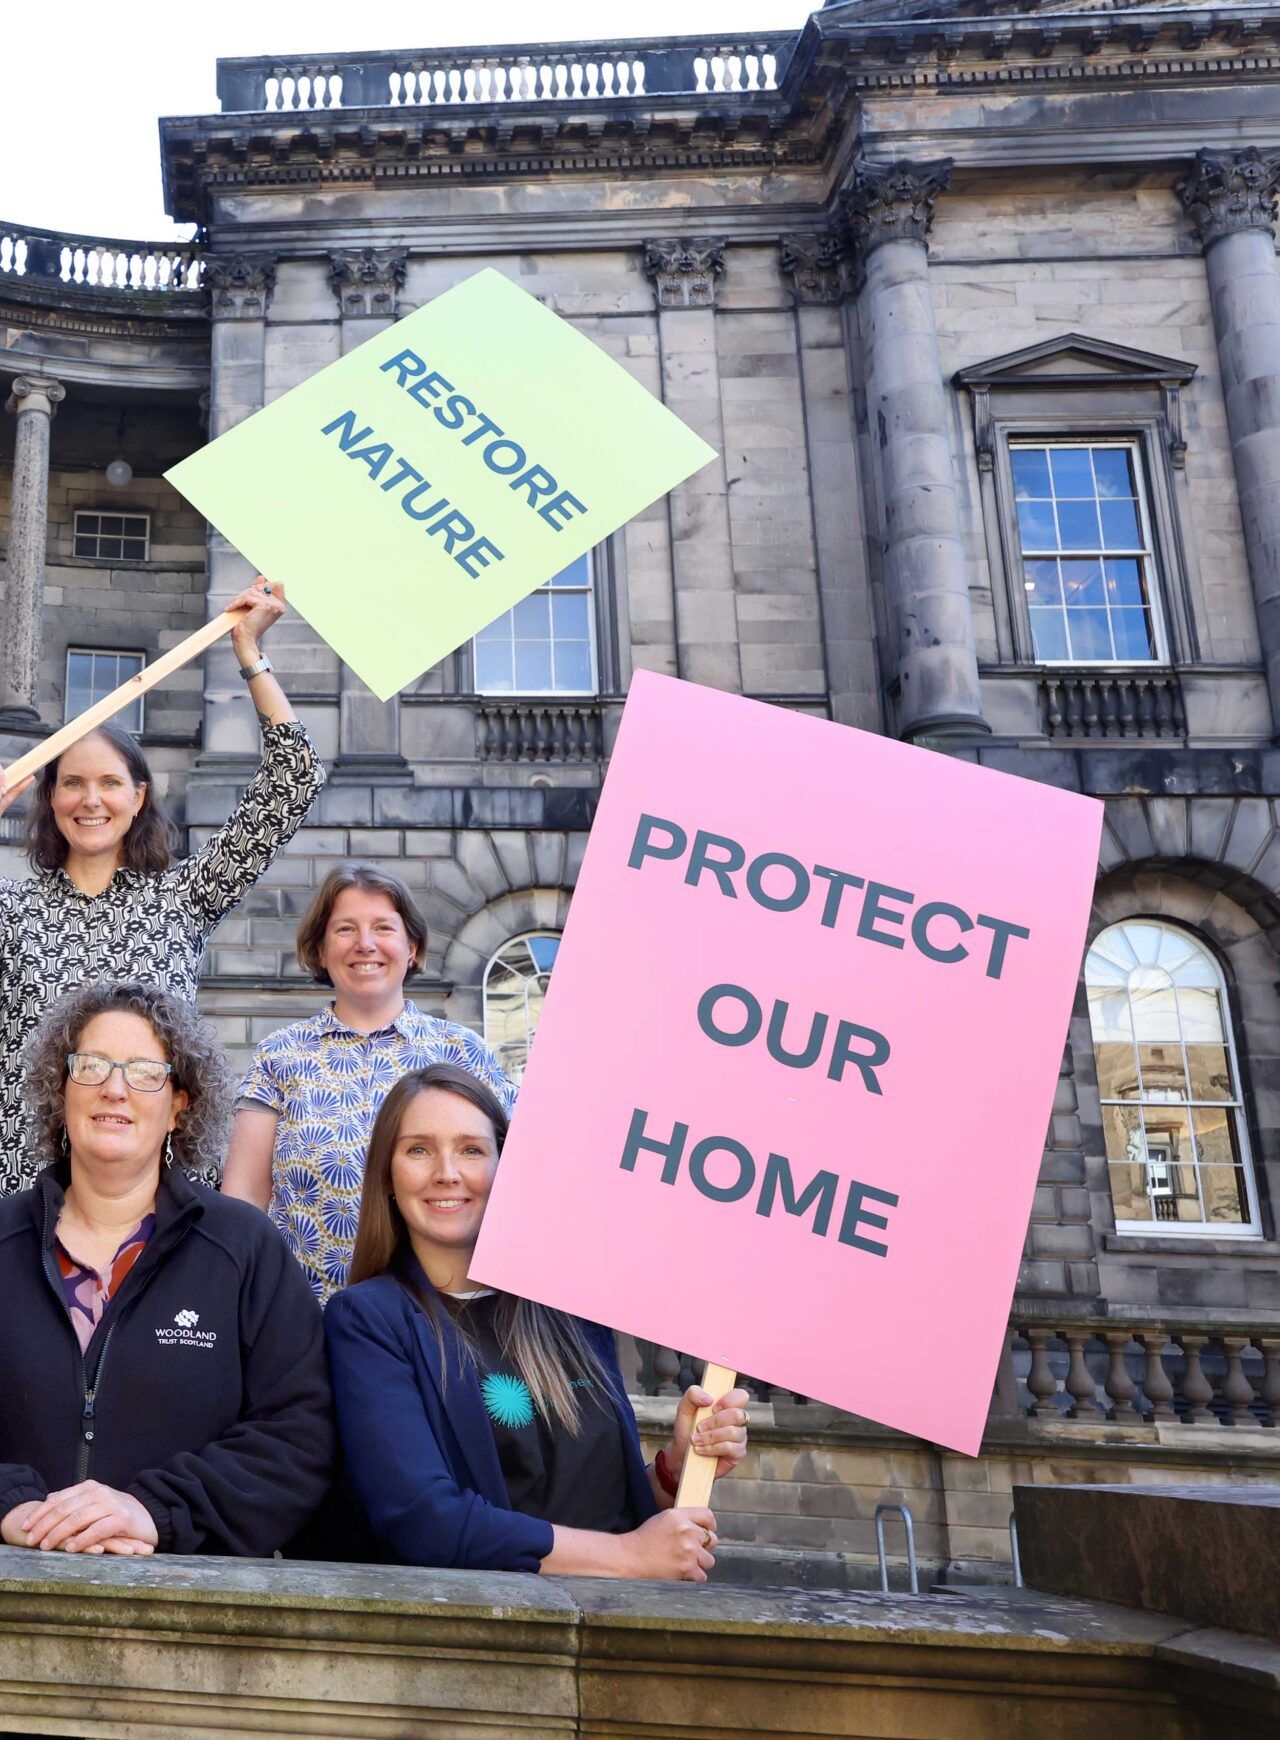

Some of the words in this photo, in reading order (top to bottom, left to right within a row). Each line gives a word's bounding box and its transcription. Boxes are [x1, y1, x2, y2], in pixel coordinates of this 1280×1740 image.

[320, 409, 505, 581] NATURE
[379, 347, 589, 533] RESTORE
[627, 813, 1031, 980] PROTECT
[697, 983, 891, 1096] OUR
[620, 1108, 900, 1258] HOME
[155, 1328, 217, 1341] WOODLAND
[179, 1338, 214, 1349] SCOTLAND
